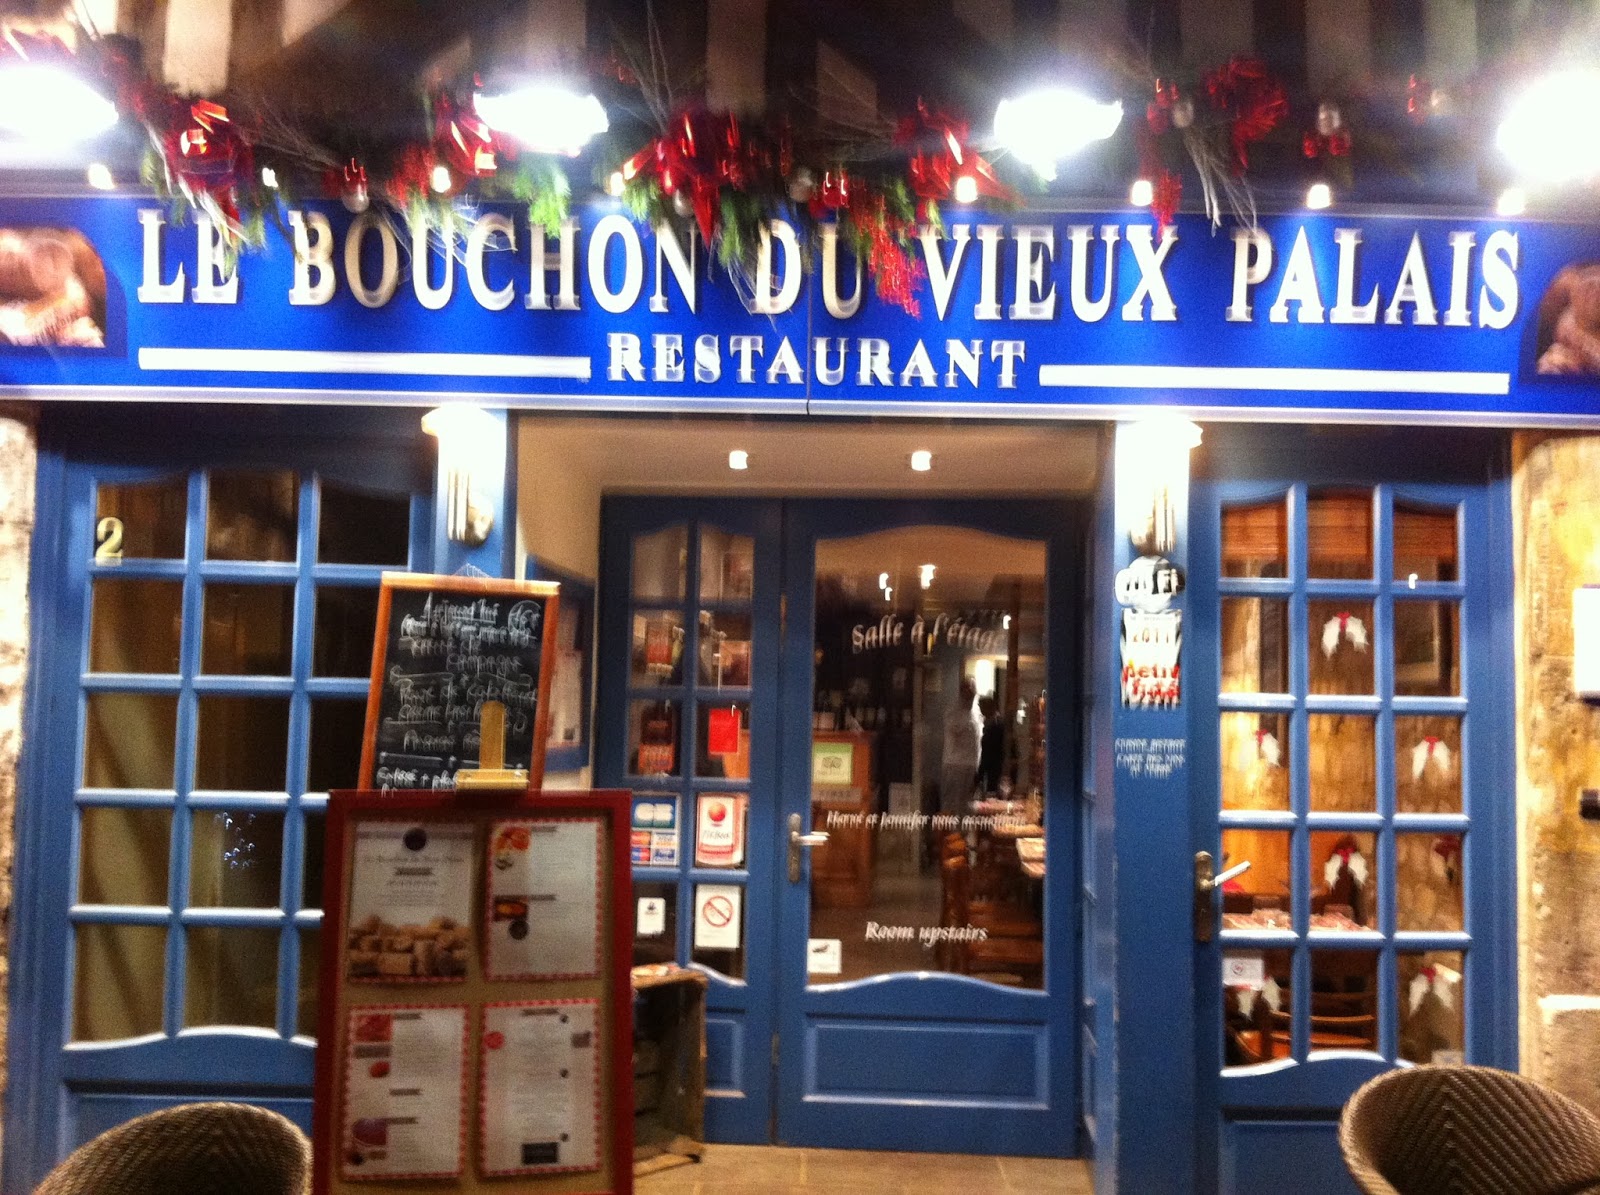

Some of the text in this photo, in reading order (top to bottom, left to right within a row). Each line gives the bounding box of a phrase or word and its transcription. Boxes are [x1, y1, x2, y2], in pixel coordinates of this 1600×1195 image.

[137, 208, 1519, 329] LE BOUCHON DU VIEUX PALAIS
[606, 332, 1026, 389] RESTAURANT
[94, 516, 124, 567] 2
[852, 612, 904, 653] Salle
[865, 921, 989, 948] Room upstairs
